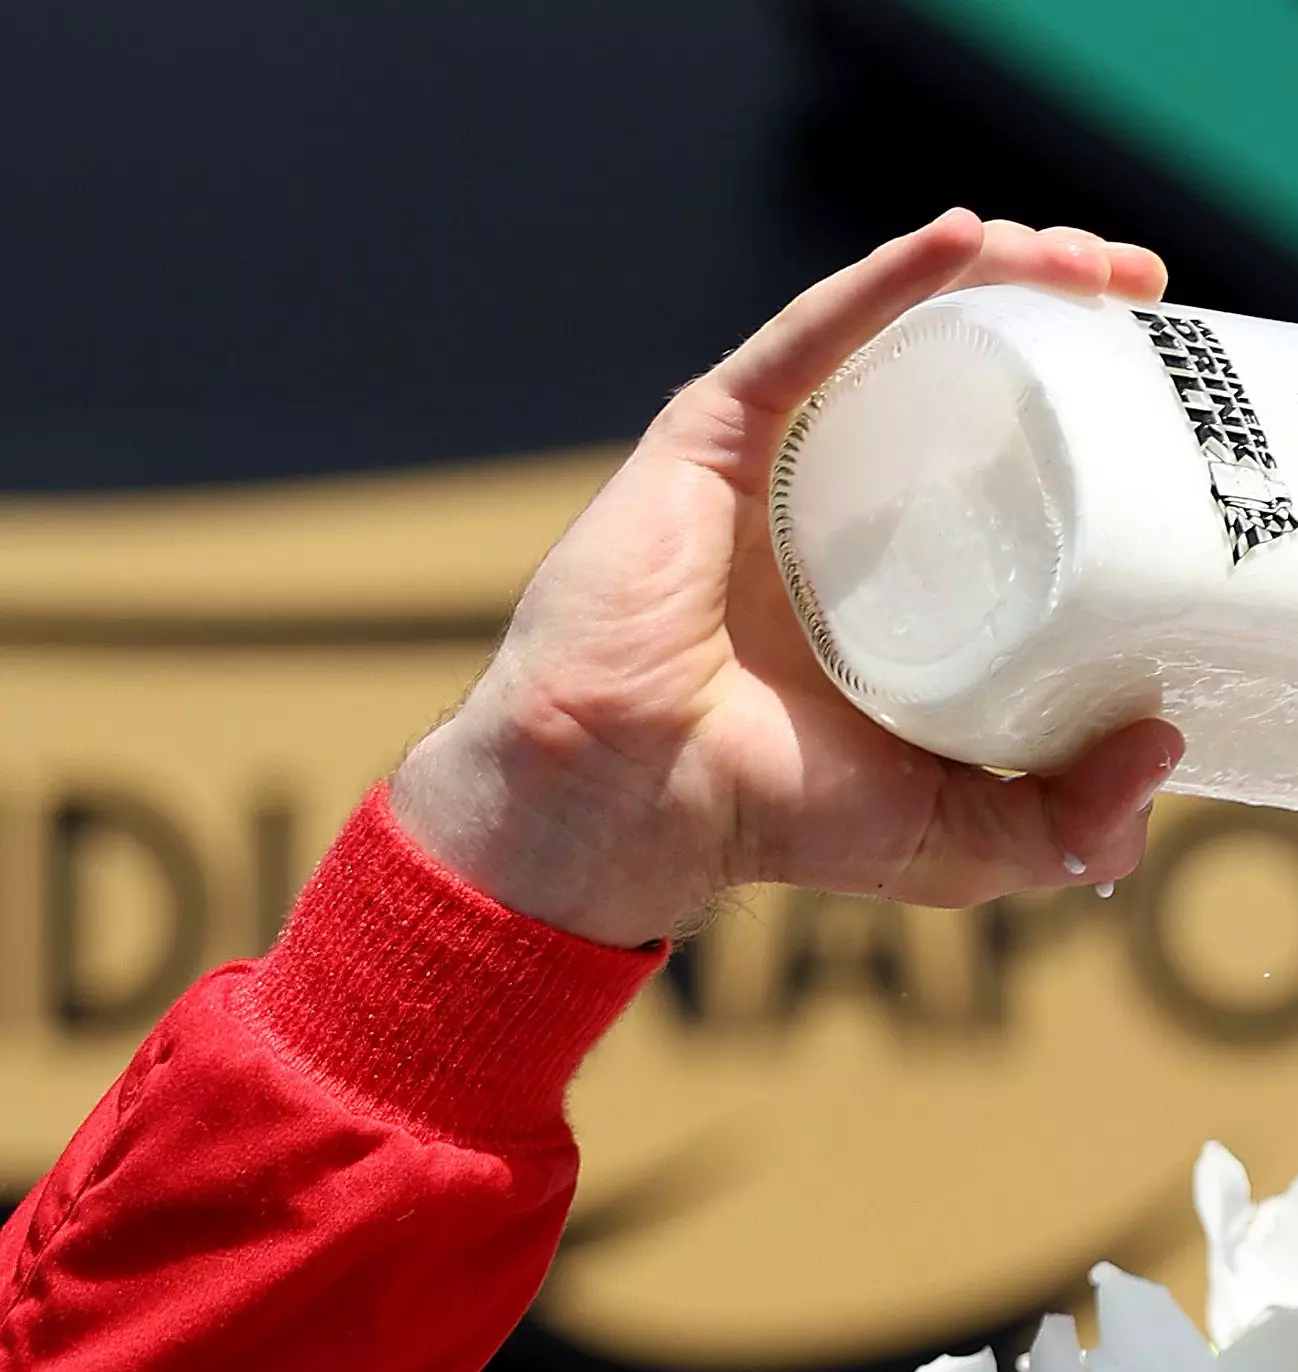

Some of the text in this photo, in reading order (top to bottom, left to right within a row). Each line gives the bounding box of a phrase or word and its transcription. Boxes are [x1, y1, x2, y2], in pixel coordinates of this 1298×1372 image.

[1129, 309, 1228, 463] MILK
[1163, 315, 1259, 469] DRINK
[1187, 318, 1278, 471] WINNERS
